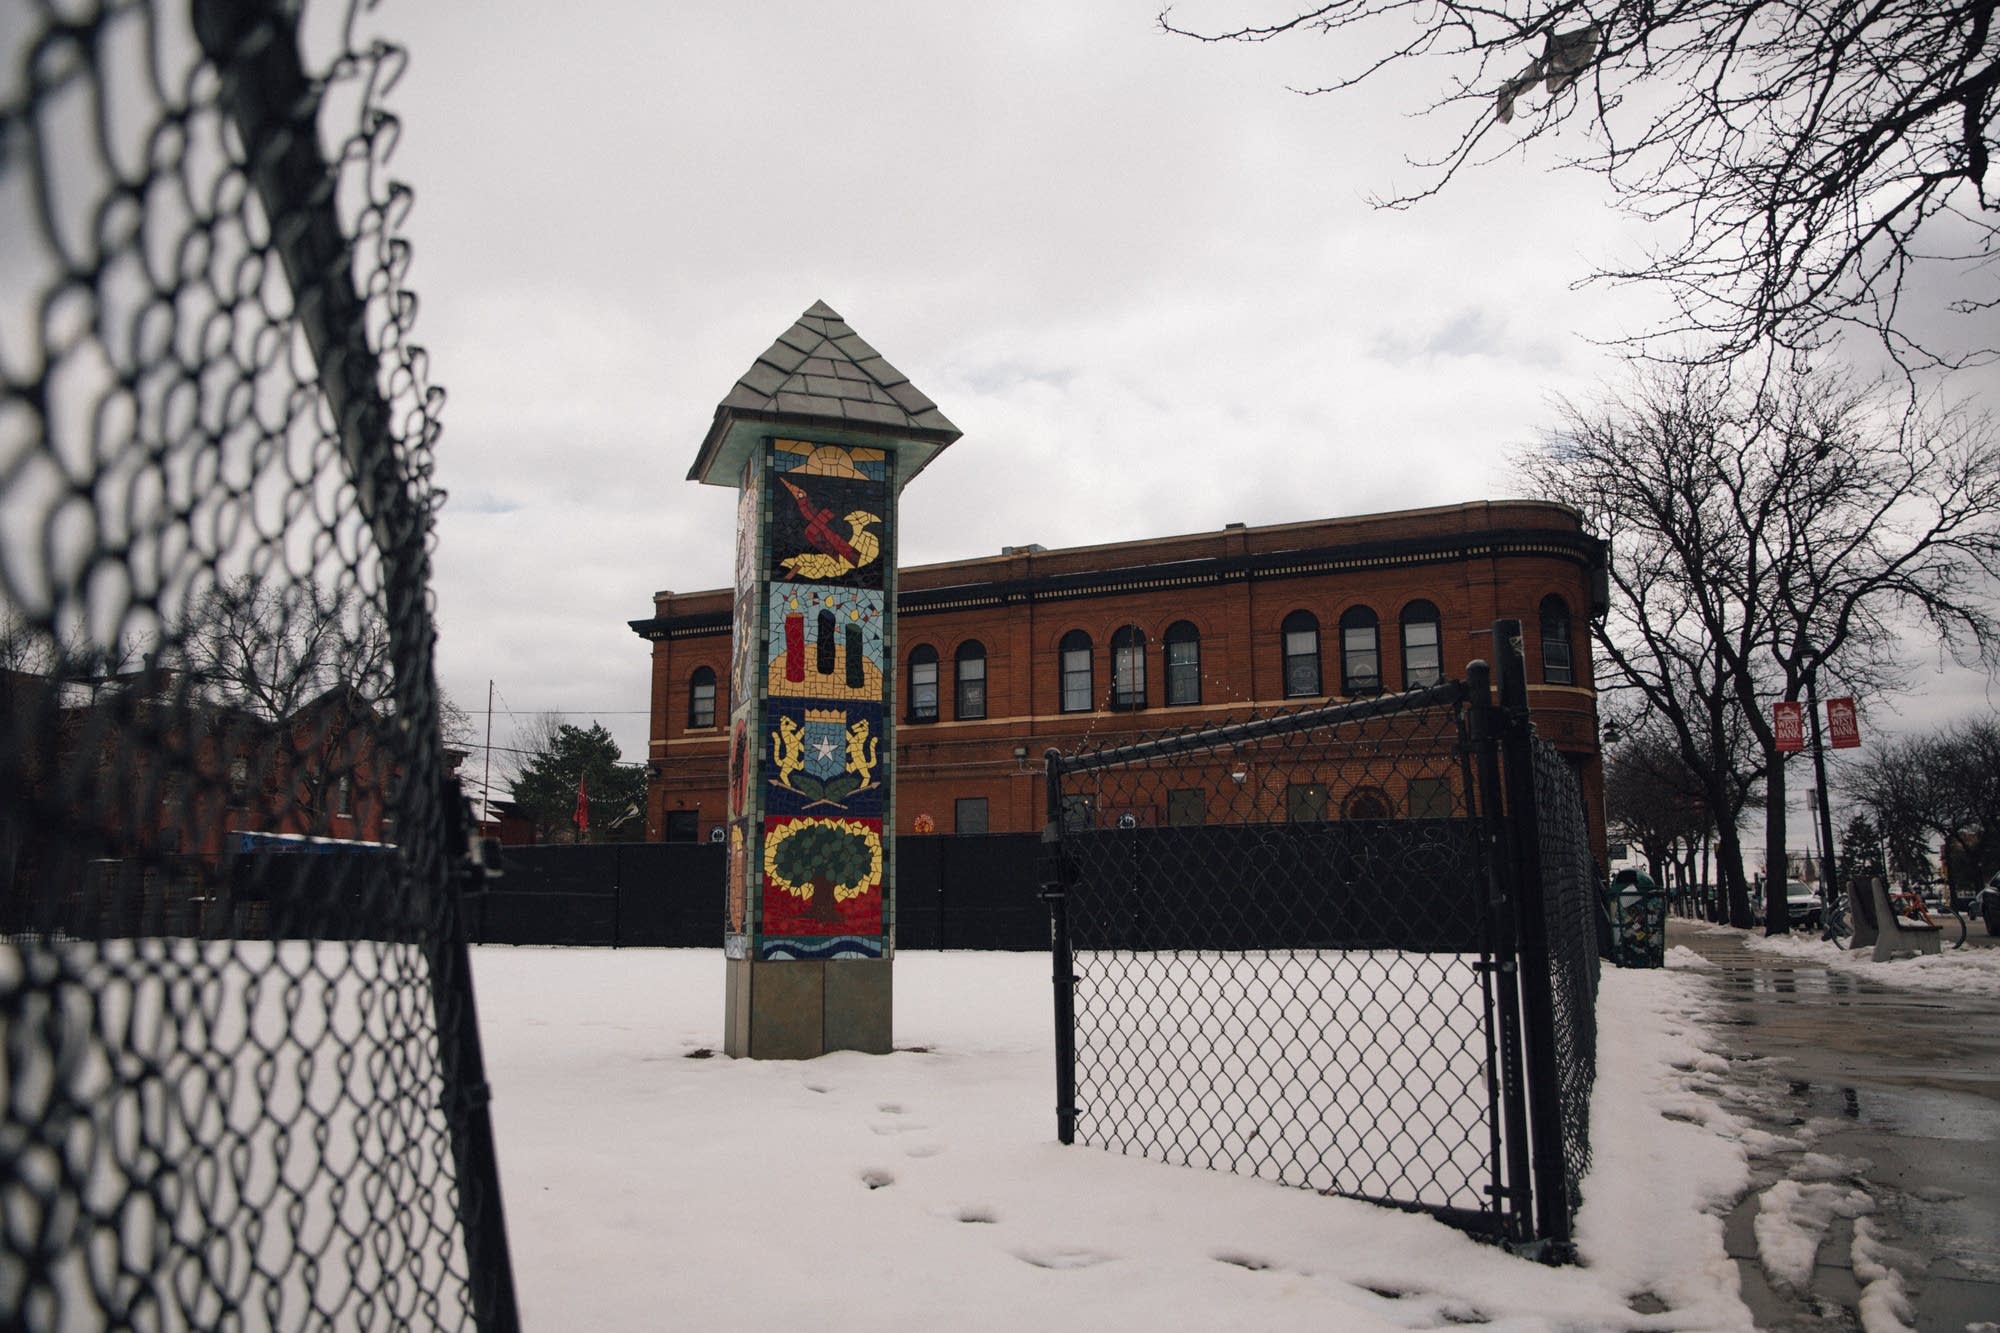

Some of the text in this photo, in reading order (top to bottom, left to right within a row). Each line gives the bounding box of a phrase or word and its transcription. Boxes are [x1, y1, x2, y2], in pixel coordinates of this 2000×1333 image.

[1777, 720, 1799, 729] WEST
[1831, 717, 1854, 727] WEST
[1778, 728, 1801, 738] BANK
[1833, 726, 1856, 736] BANK
